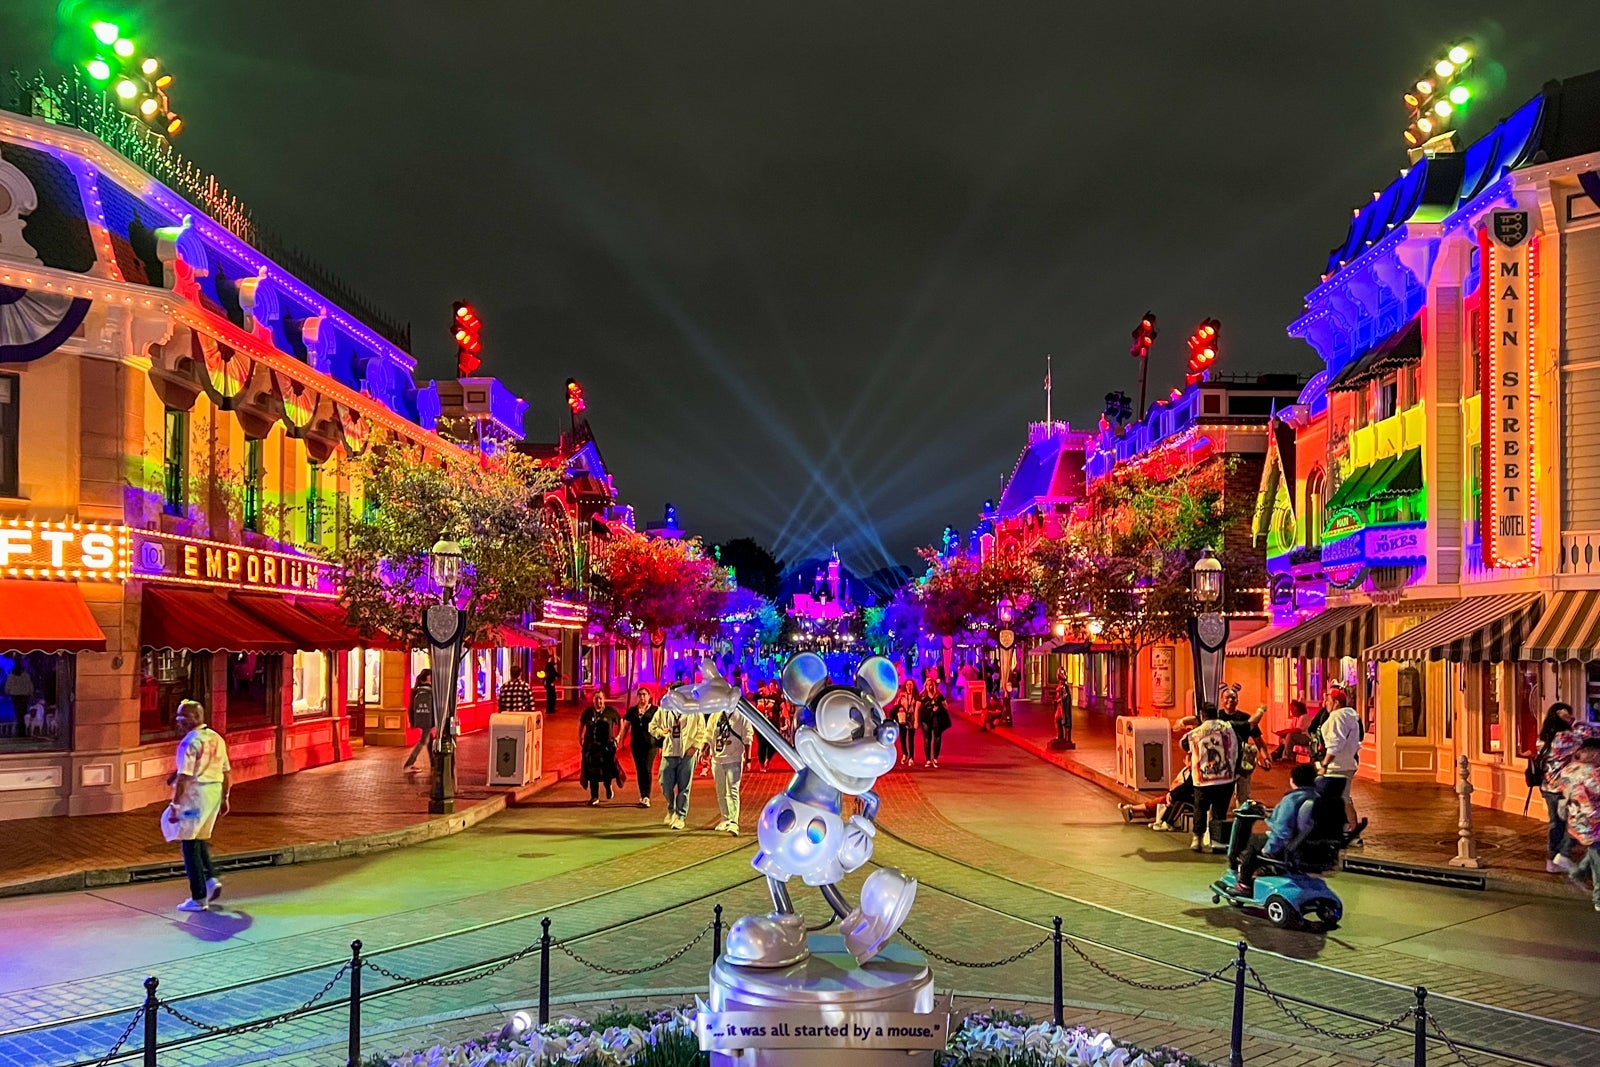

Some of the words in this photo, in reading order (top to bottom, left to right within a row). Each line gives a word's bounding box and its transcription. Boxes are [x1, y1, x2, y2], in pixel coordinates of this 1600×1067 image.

[1500, 262, 1519, 346] MAIN
[1502, 372, 1520, 502] STREET
[1374, 534, 1418, 553] JOKES
[1499, 515, 1526, 536] HOTEL
[0, 529, 115, 568] FTS
[184, 544, 319, 590] EMPORIUM
[726, 1024, 737, 1036] it
[740, 1027, 766, 1036] was
[771, 1023, 790, 1036] all
[794, 1023, 848, 1037] started
[853, 1023, 871, 1040] by
[875, 1026, 884, 1037] a
